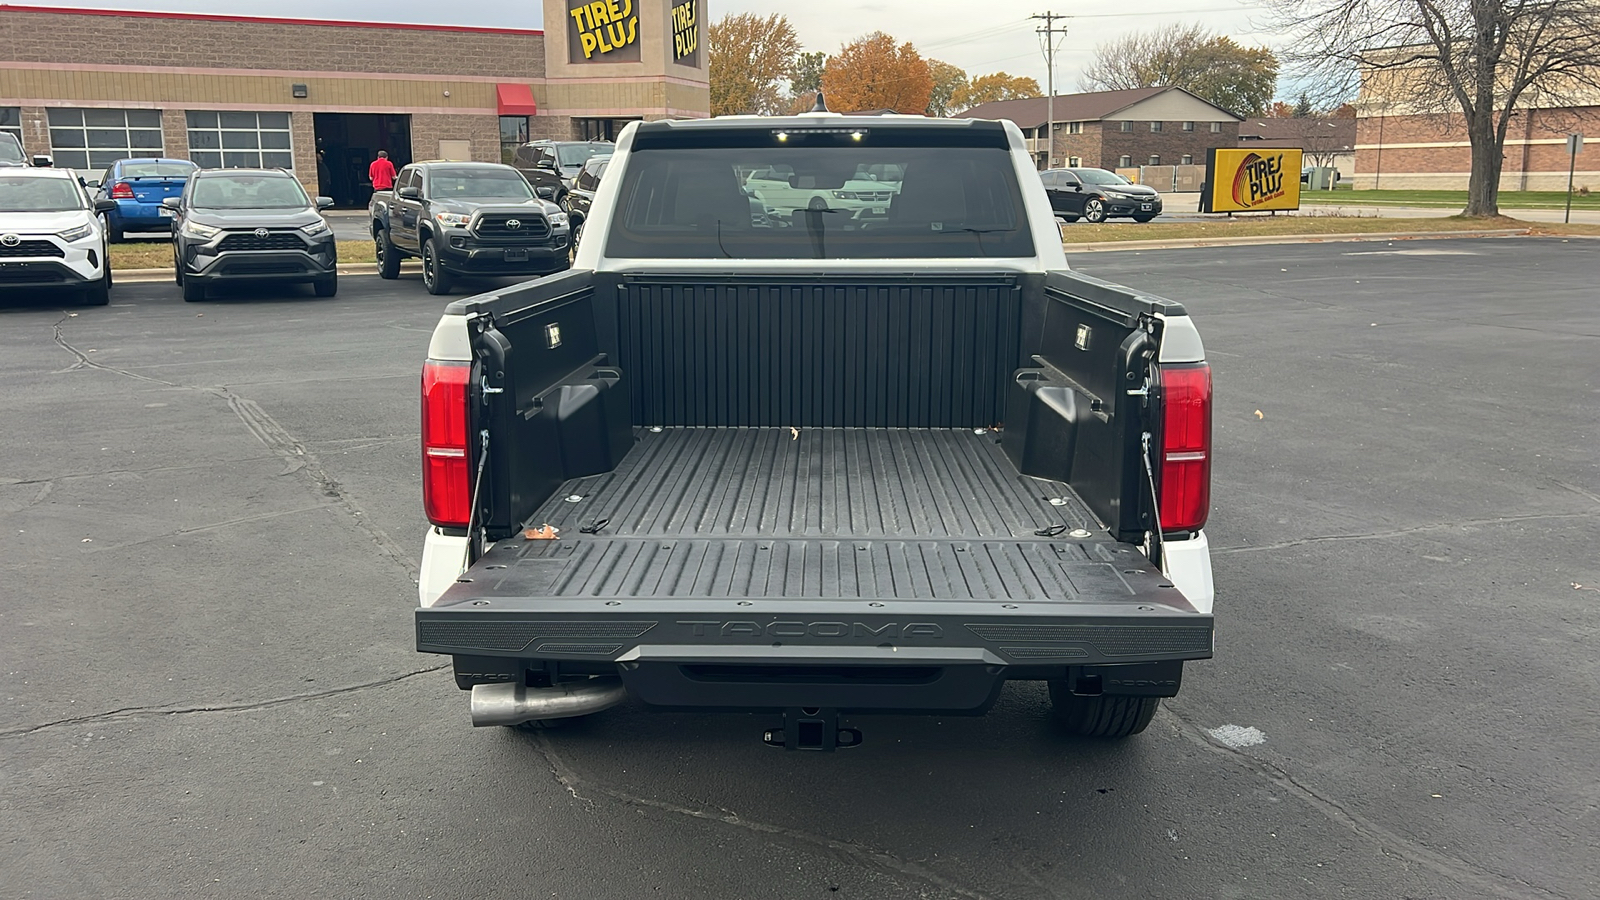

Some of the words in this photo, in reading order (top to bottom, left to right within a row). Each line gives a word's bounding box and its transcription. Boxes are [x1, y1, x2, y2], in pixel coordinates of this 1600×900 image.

[570, 0, 632, 33] TIRES
[671, 0, 697, 33] TIRES
[580, 16, 638, 59] PLUS
[675, 25, 698, 60] PLUS
[1246, 153, 1284, 183] TIRES
[1249, 172, 1284, 202] PLUS
[675, 620, 944, 639] TACOMA
[457, 672, 516, 681] TACO
